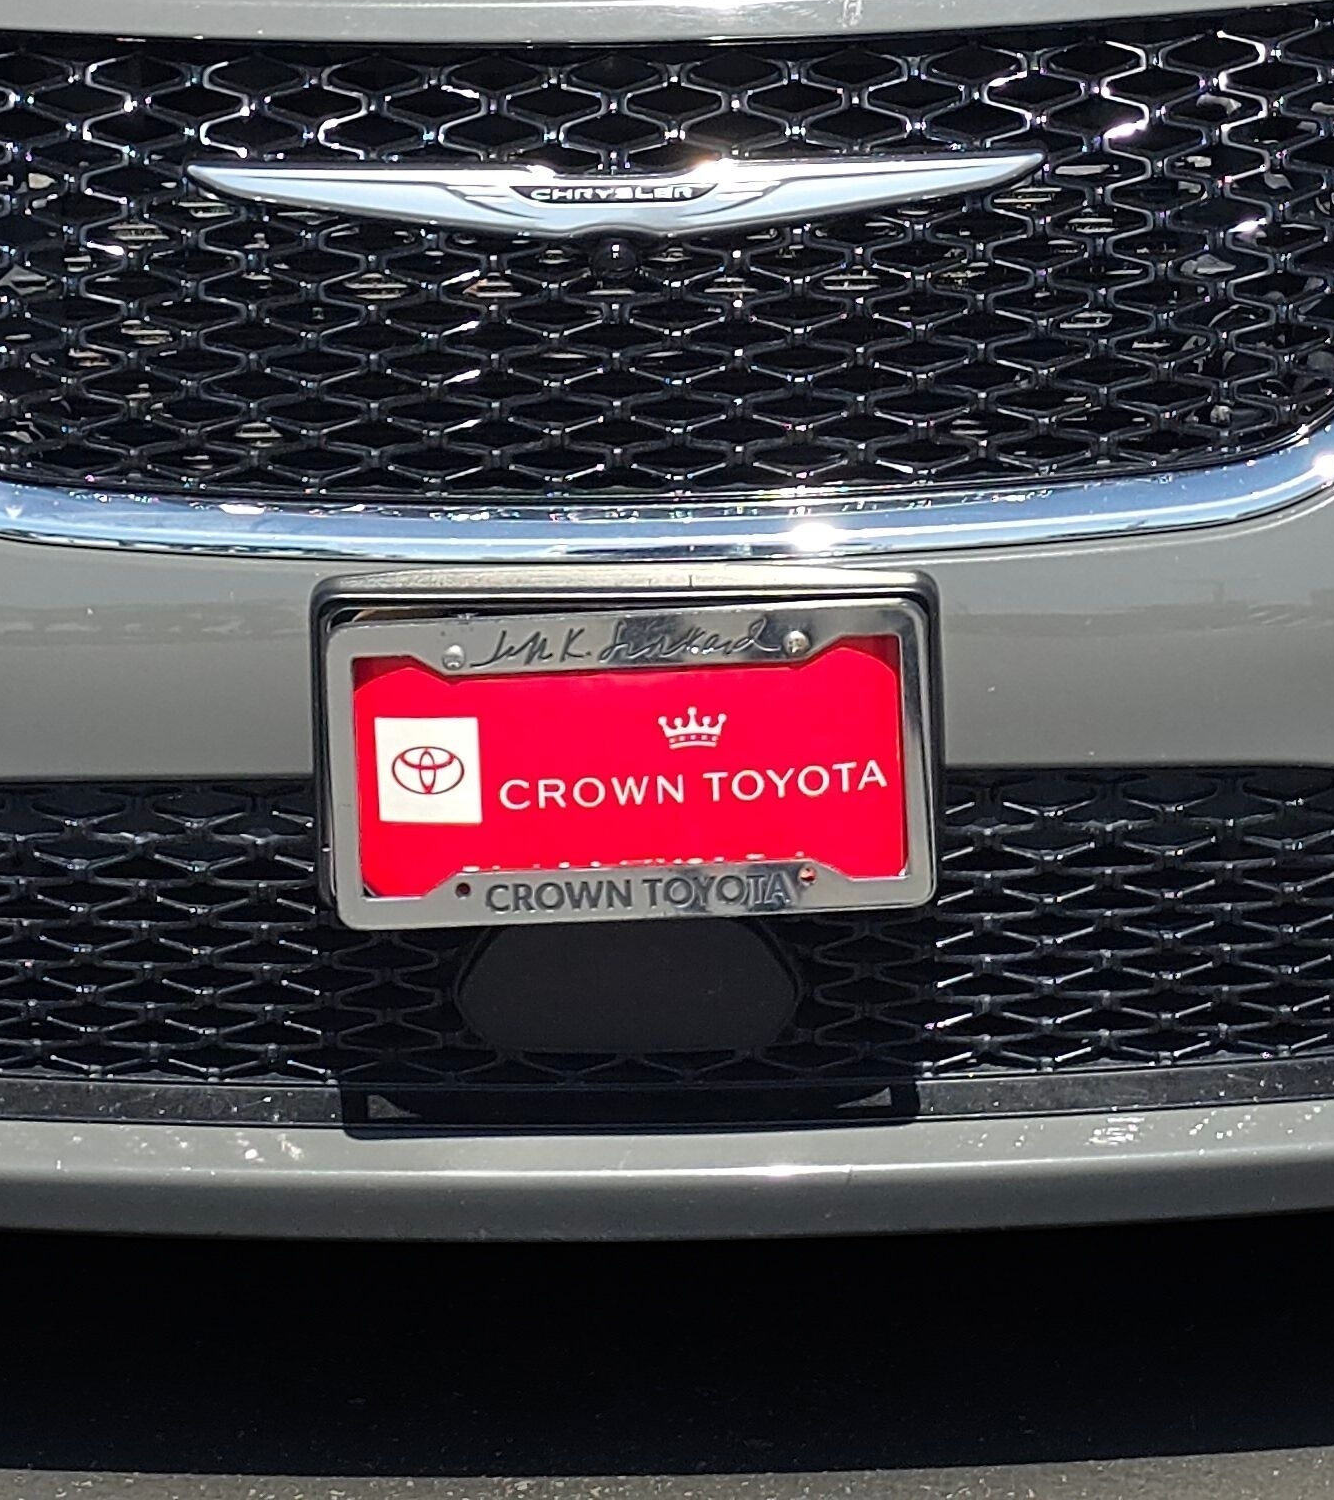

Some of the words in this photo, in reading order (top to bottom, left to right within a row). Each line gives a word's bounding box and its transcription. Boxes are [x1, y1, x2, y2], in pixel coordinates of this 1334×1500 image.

[530, 185, 693, 200] CHRYSLER
[498, 773, 685, 811] CROWN
[702, 758, 888, 803] TOYOTA
[485, 879, 632, 915] CROWN
[642, 873, 792, 908] TOYOTA
